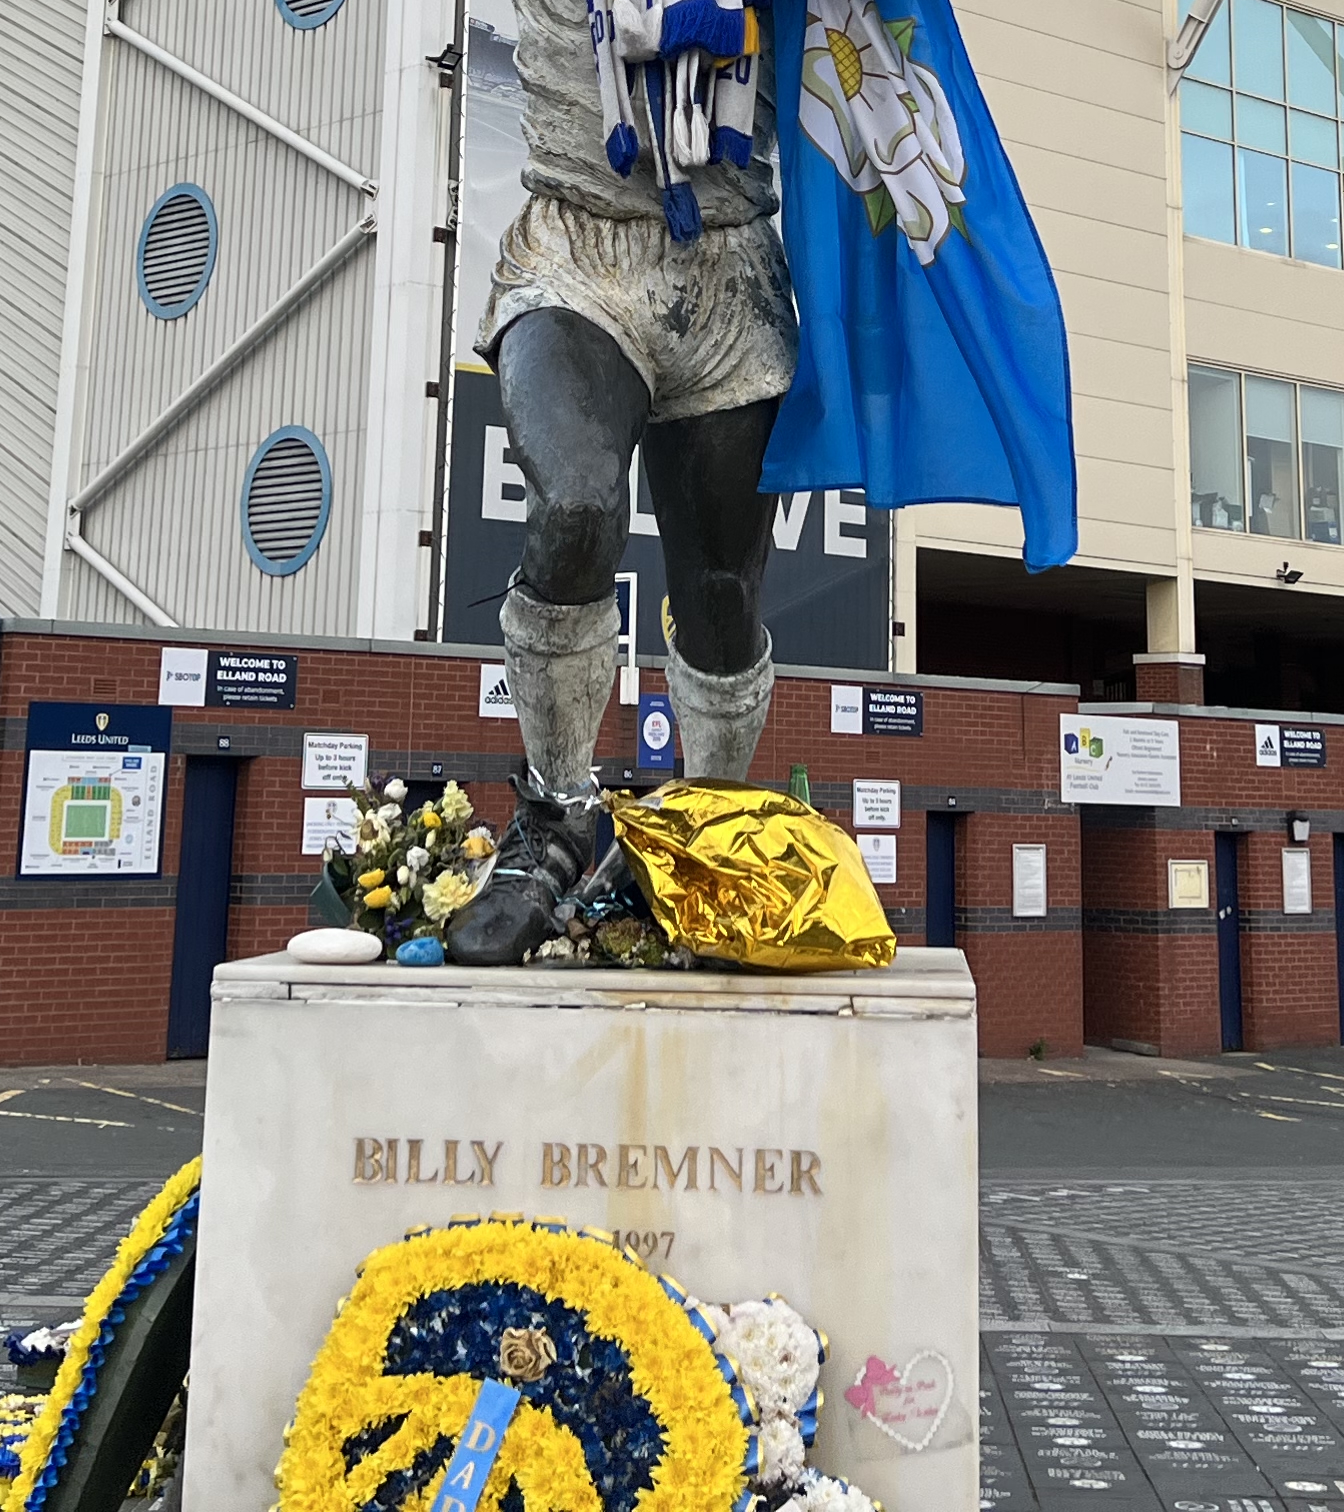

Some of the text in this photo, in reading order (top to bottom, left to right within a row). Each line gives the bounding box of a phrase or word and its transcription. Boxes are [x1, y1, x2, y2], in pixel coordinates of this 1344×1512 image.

[219, 656, 286, 670] WELCOME TO
[217, 669, 287, 683] ELLAND ROAD
[869, 693, 916, 704] WELCOME TO
[869, 704, 895, 714] ELLAND
[896, 706, 917, 715] ROAD
[71, 733, 129, 746] LEEDS UNITED
[219, 738, 230, 748] 88
[1081, 735, 1087, 746] B
[1071, 740, 1076, 752] A
[1090, 745, 1097, 755] C
[315, 754, 324, 762] Up
[432, 765, 442, 774] 87
[624, 770, 632, 779] 86
[352, 1136, 824, 1196] BILLY BREMNER
[612, 1230, 675, 1260] 1997
